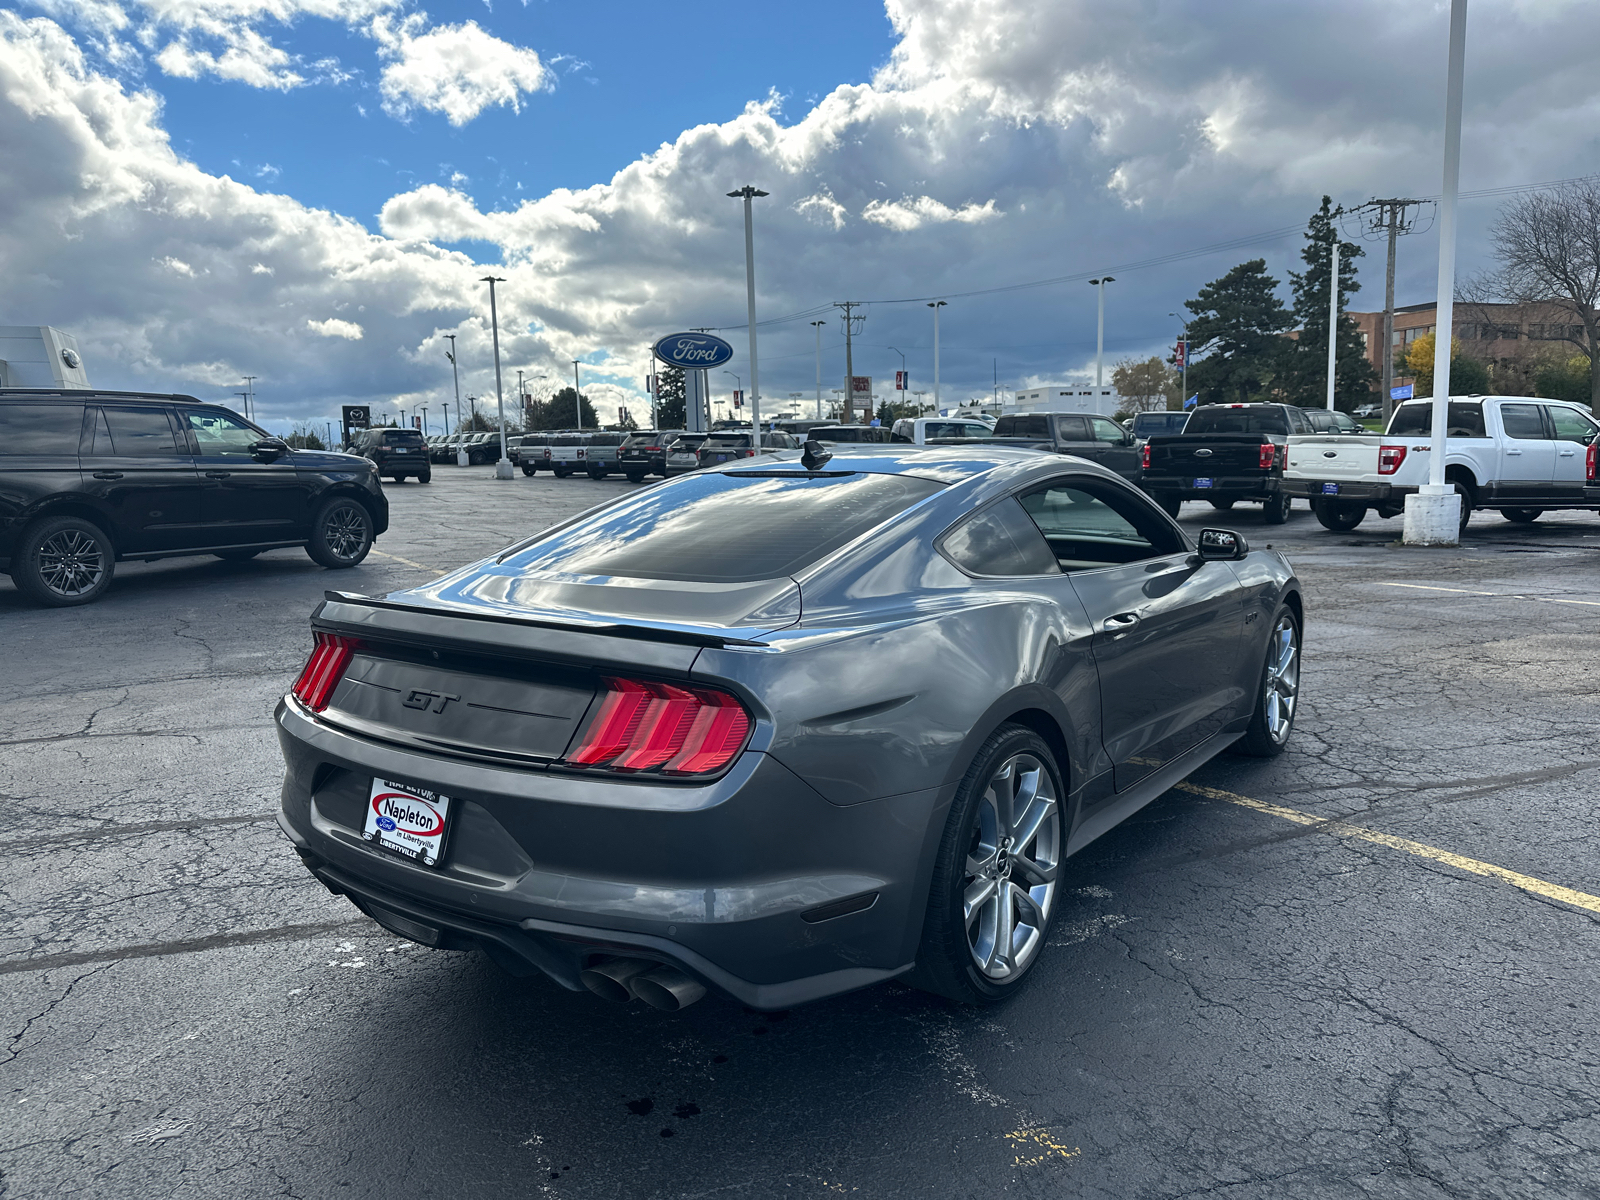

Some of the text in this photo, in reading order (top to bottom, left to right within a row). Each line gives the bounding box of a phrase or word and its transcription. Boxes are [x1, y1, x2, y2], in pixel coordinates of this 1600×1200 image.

[673, 338, 718, 361] Ford
[402, 687, 461, 714] GT
[379, 817, 394, 830] Ford
[383, 797, 433, 830] Napleton
[379, 838, 417, 859] LIBERTYVILLE
[402, 832, 435, 850] Libertyville
